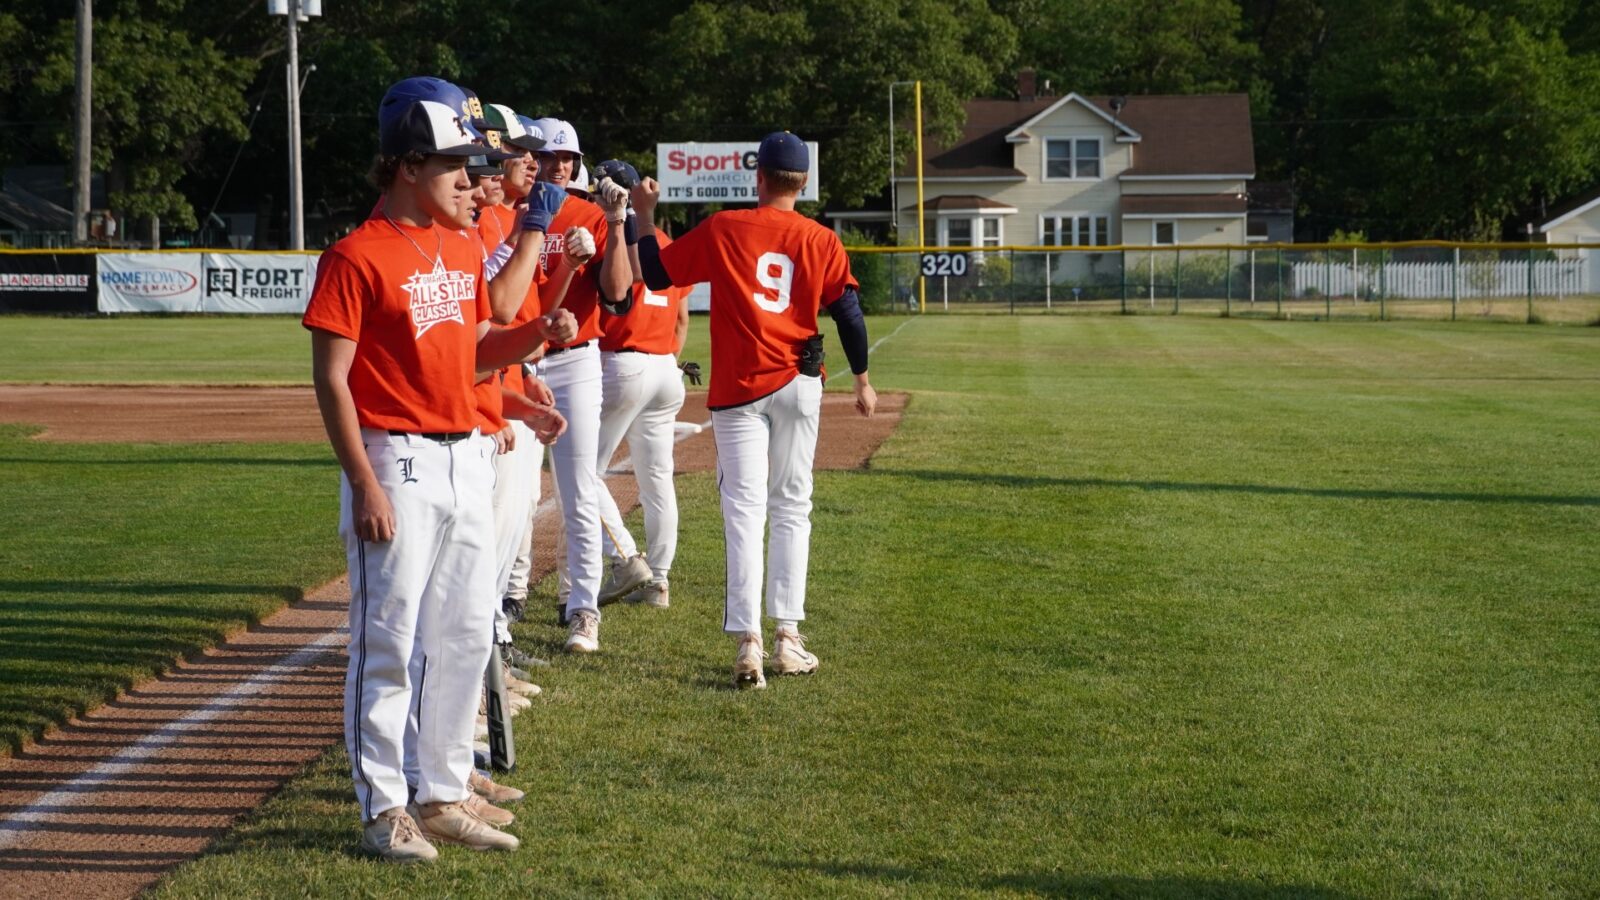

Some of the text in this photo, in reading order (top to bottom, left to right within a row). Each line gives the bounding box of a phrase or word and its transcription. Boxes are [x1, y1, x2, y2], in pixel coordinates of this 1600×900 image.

[668, 150, 759, 175] SportC
[697, 173, 752, 183] HAIRCU
[668, 187, 693, 197] IT'S
[697, 187, 729, 197] GOOD
[732, 187, 748, 197] TO
[922, 254, 967, 276] 320
[0, 275, 87, 285] LANGLOIS
[101, 271, 188, 284] HOMETOWN
[242, 268, 304, 286] FORT
[753, 251, 795, 314] 9
[115, 284, 184, 293] PHARMACY
[242, 287, 302, 299] FREIGHT
[414, 301, 459, 323] CLASSIC
